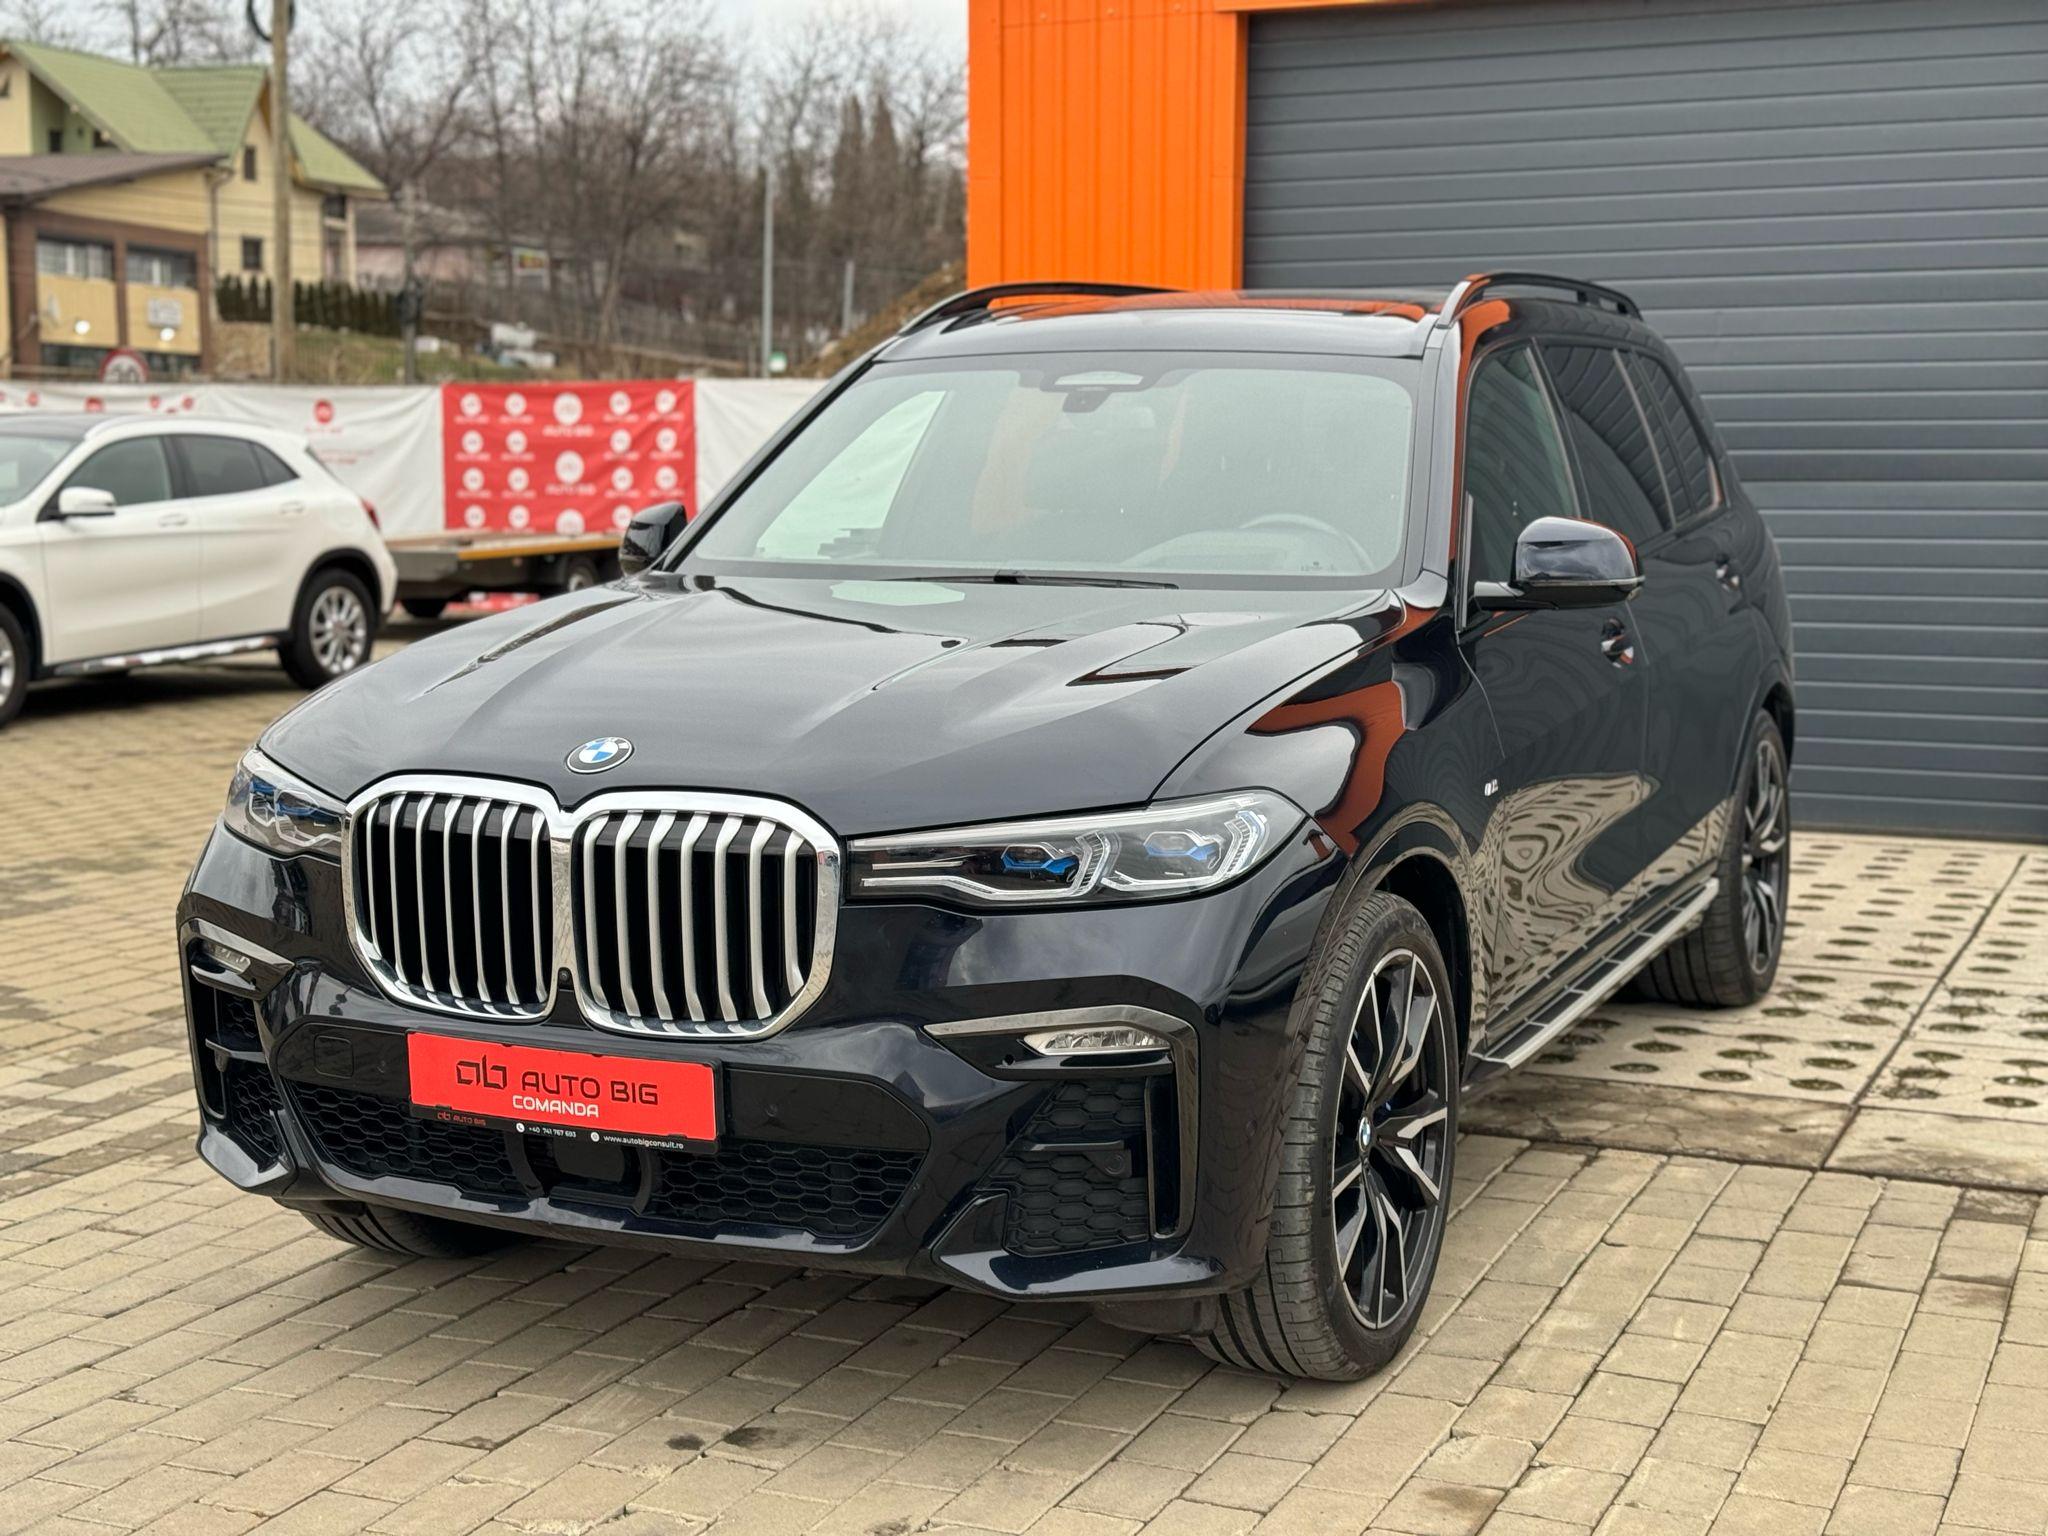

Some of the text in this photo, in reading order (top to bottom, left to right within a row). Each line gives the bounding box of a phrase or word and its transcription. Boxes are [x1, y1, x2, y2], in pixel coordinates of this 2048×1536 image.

[521, 1071, 658, 1105] AUTO BIG
[512, 1095, 599, 1118] COMANDA
[453, 1114, 473, 1124] AUTO
[603, 1135, 684, 1149] www.autobigconsult.ro
